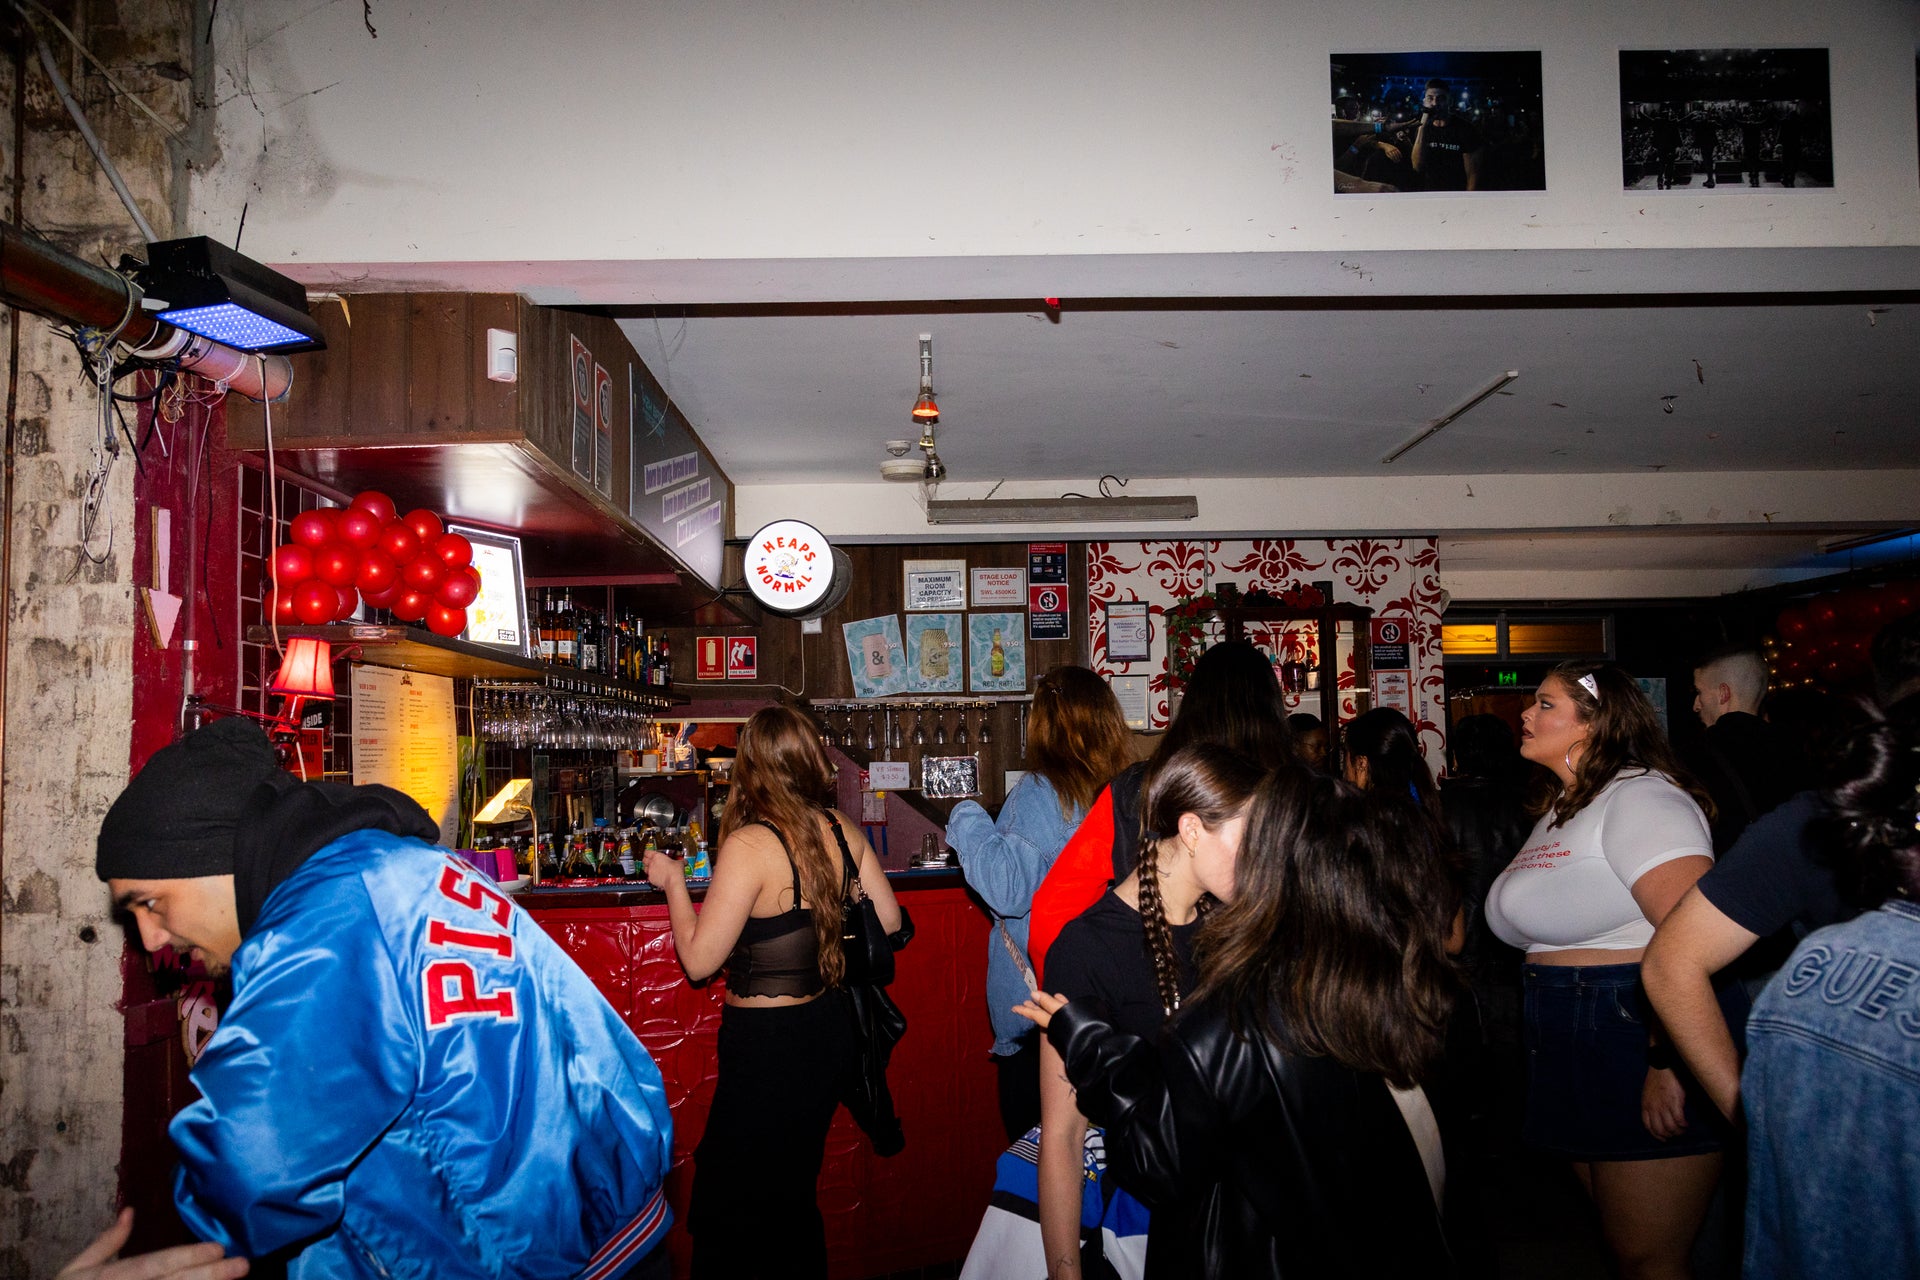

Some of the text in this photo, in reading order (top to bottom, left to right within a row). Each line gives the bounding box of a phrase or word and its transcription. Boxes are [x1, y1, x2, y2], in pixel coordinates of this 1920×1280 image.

[762, 537, 816, 562] HEAPS
[757, 565, 812, 593] NORMAL
[303, 712, 323, 728] NSIDE
[1537, 849, 1571, 859] these
[421, 853, 519, 1032] PIS
